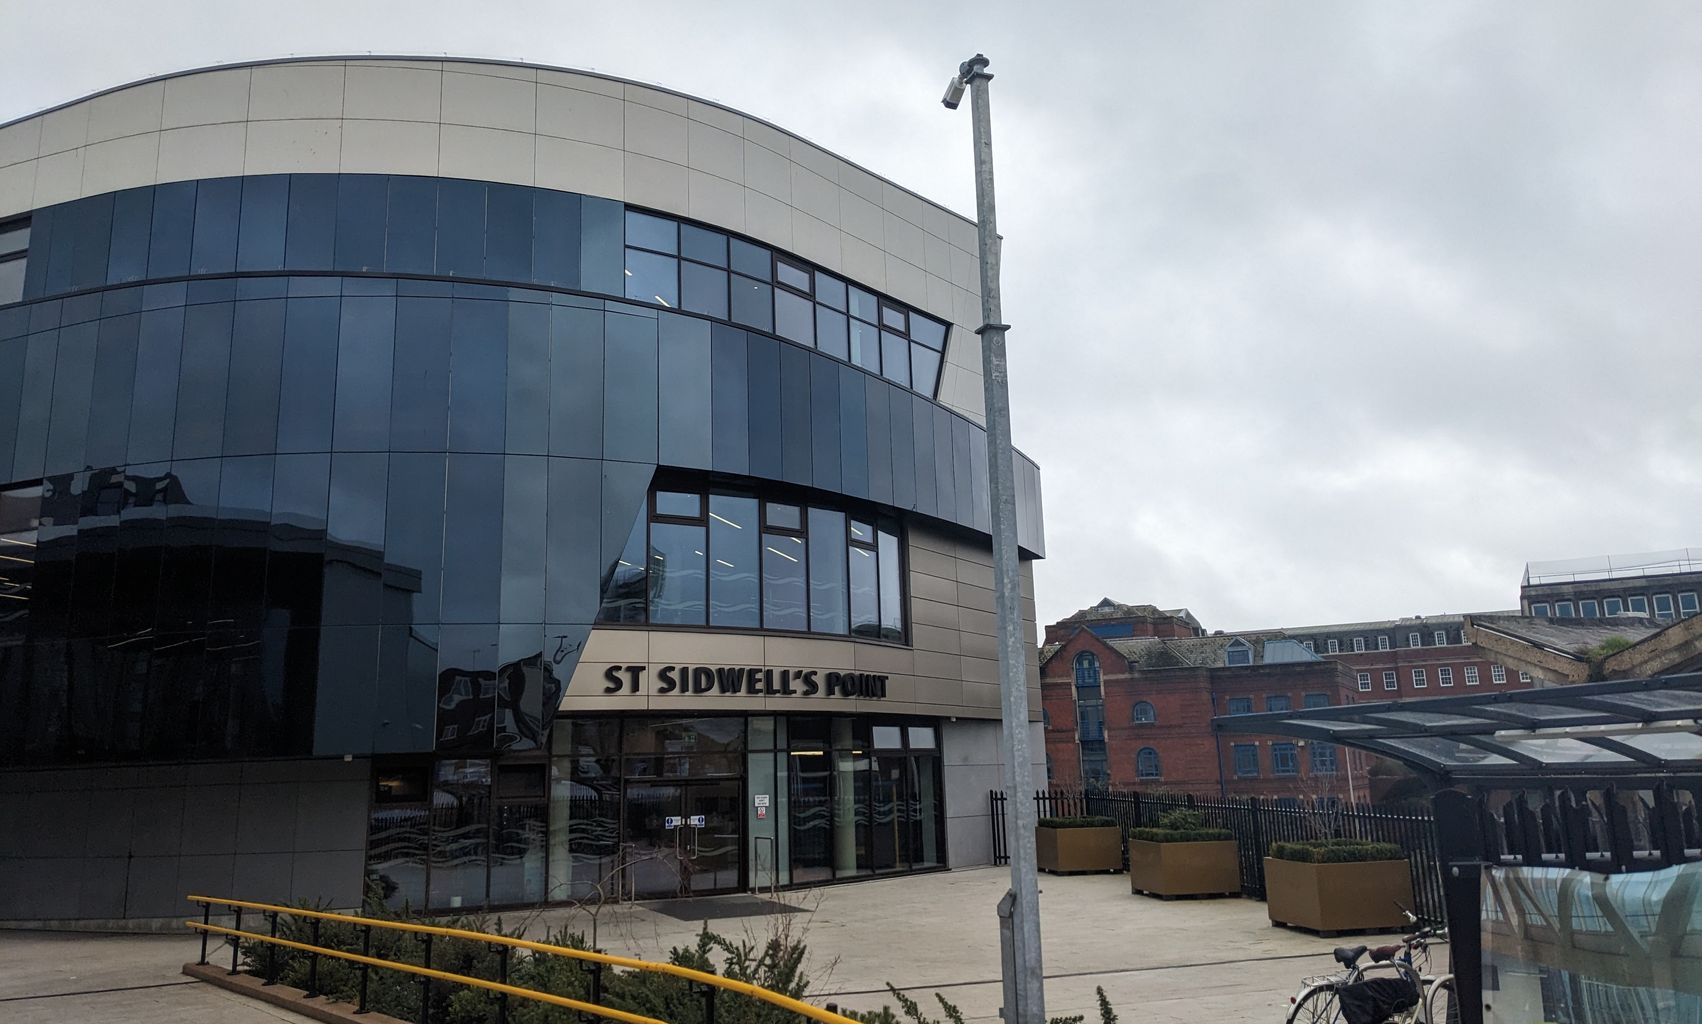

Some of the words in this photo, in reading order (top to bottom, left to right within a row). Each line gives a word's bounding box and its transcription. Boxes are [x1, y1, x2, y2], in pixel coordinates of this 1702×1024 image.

[604, 665, 646, 694] ST
[657, 665, 818, 696] SIDWELL'S
[825, 671, 889, 699] POINT
